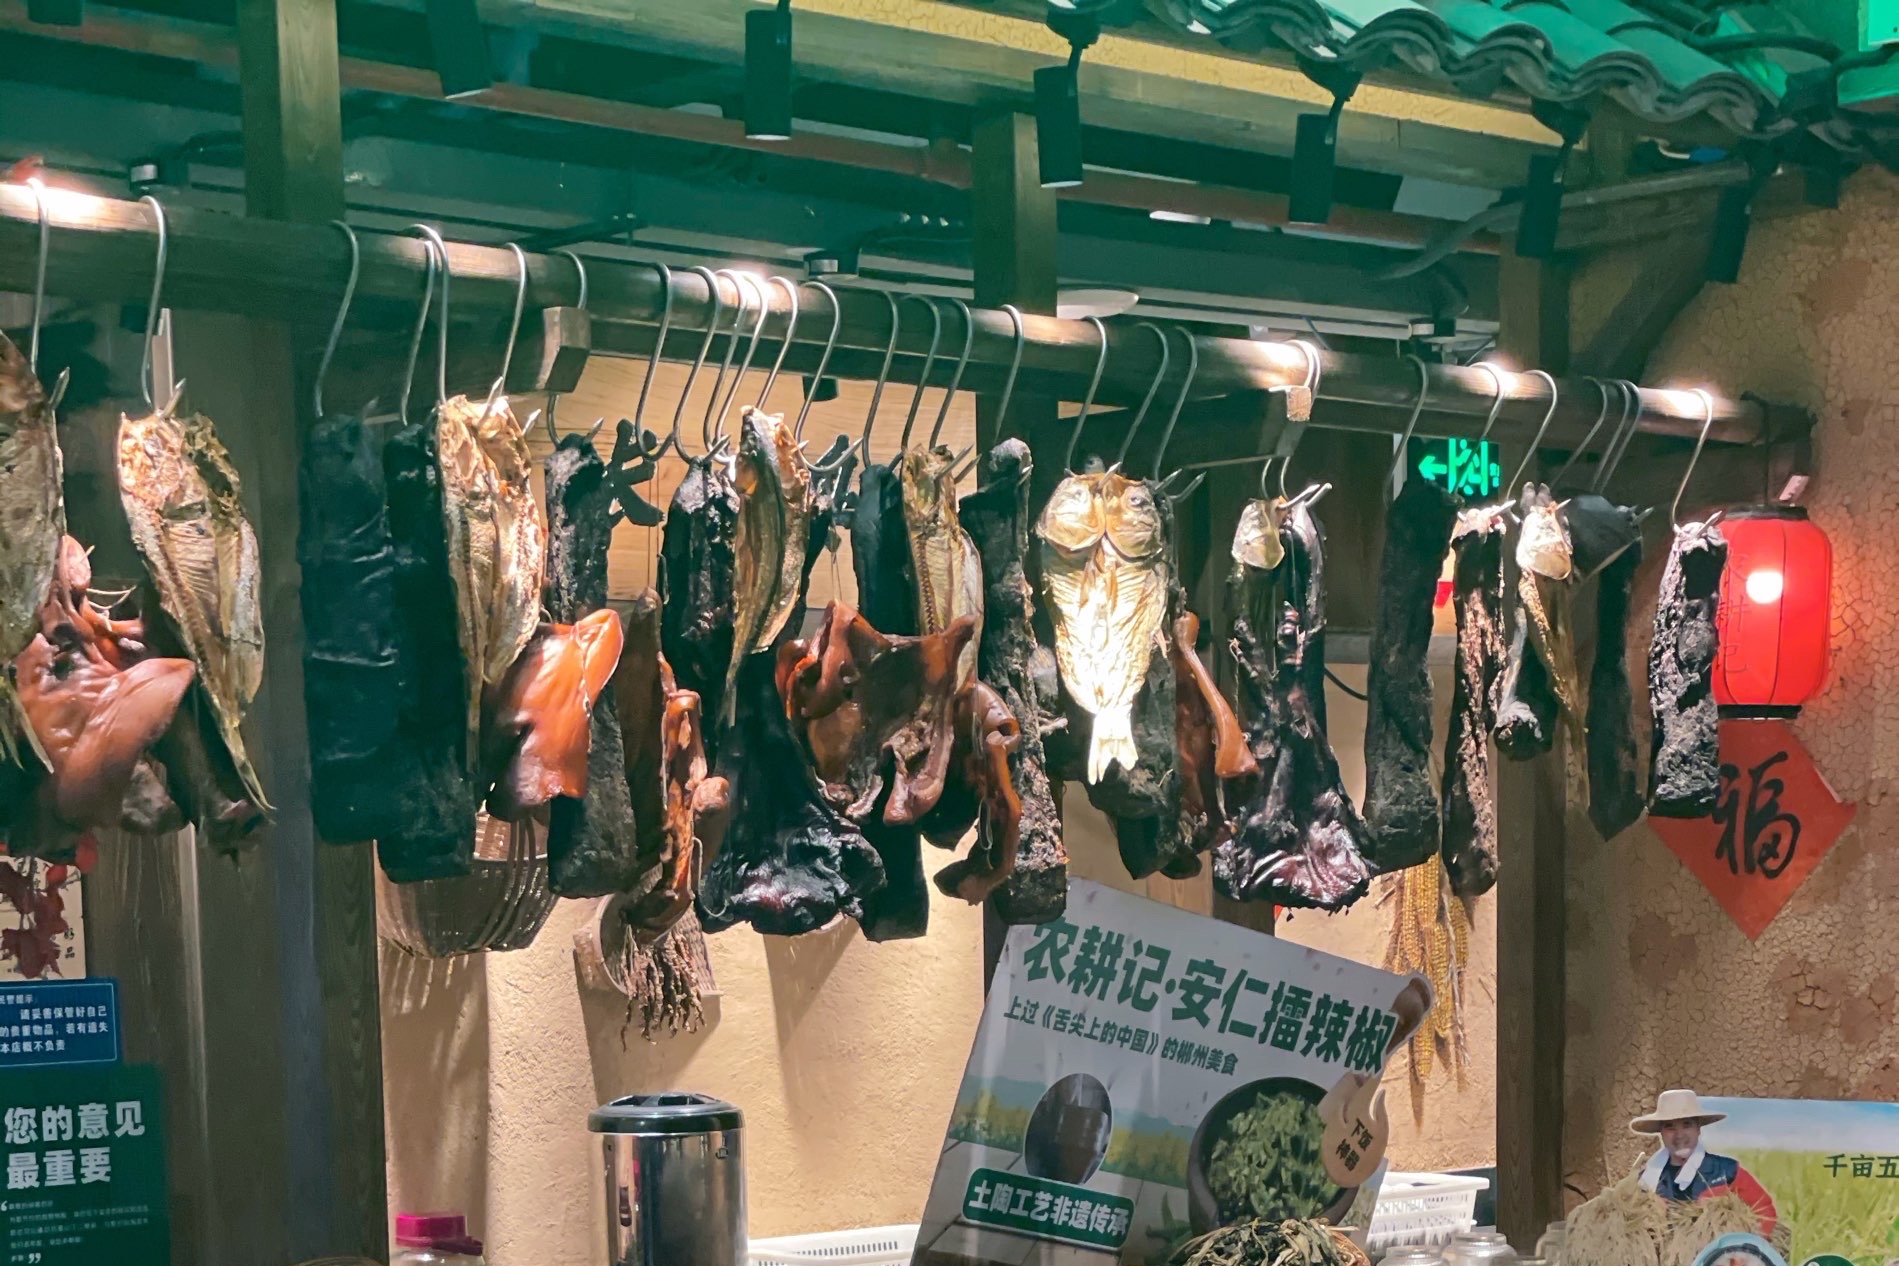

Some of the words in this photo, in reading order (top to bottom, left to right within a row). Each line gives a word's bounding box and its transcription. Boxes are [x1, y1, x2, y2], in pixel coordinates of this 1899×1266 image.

[1712, 751, 1801, 880] 福
[20, 1005, 108, 1020] 请妥善保管好自己
[1023, 917, 1399, 1075] 农耕记·安仁擂辣椒
[1, 1039, 65, 1054] 本店概不负责
[1003, 996, 1239, 1076] 上过《舌尖上的中国》的郴州美食
[4, 1100, 146, 1145] 您的意见
[7, 1146, 113, 1190] 最重要
[1823, 1153, 1899, 1178] 千亩五
[968, 1179, 1130, 1237] 土陶工艺非遗传承
